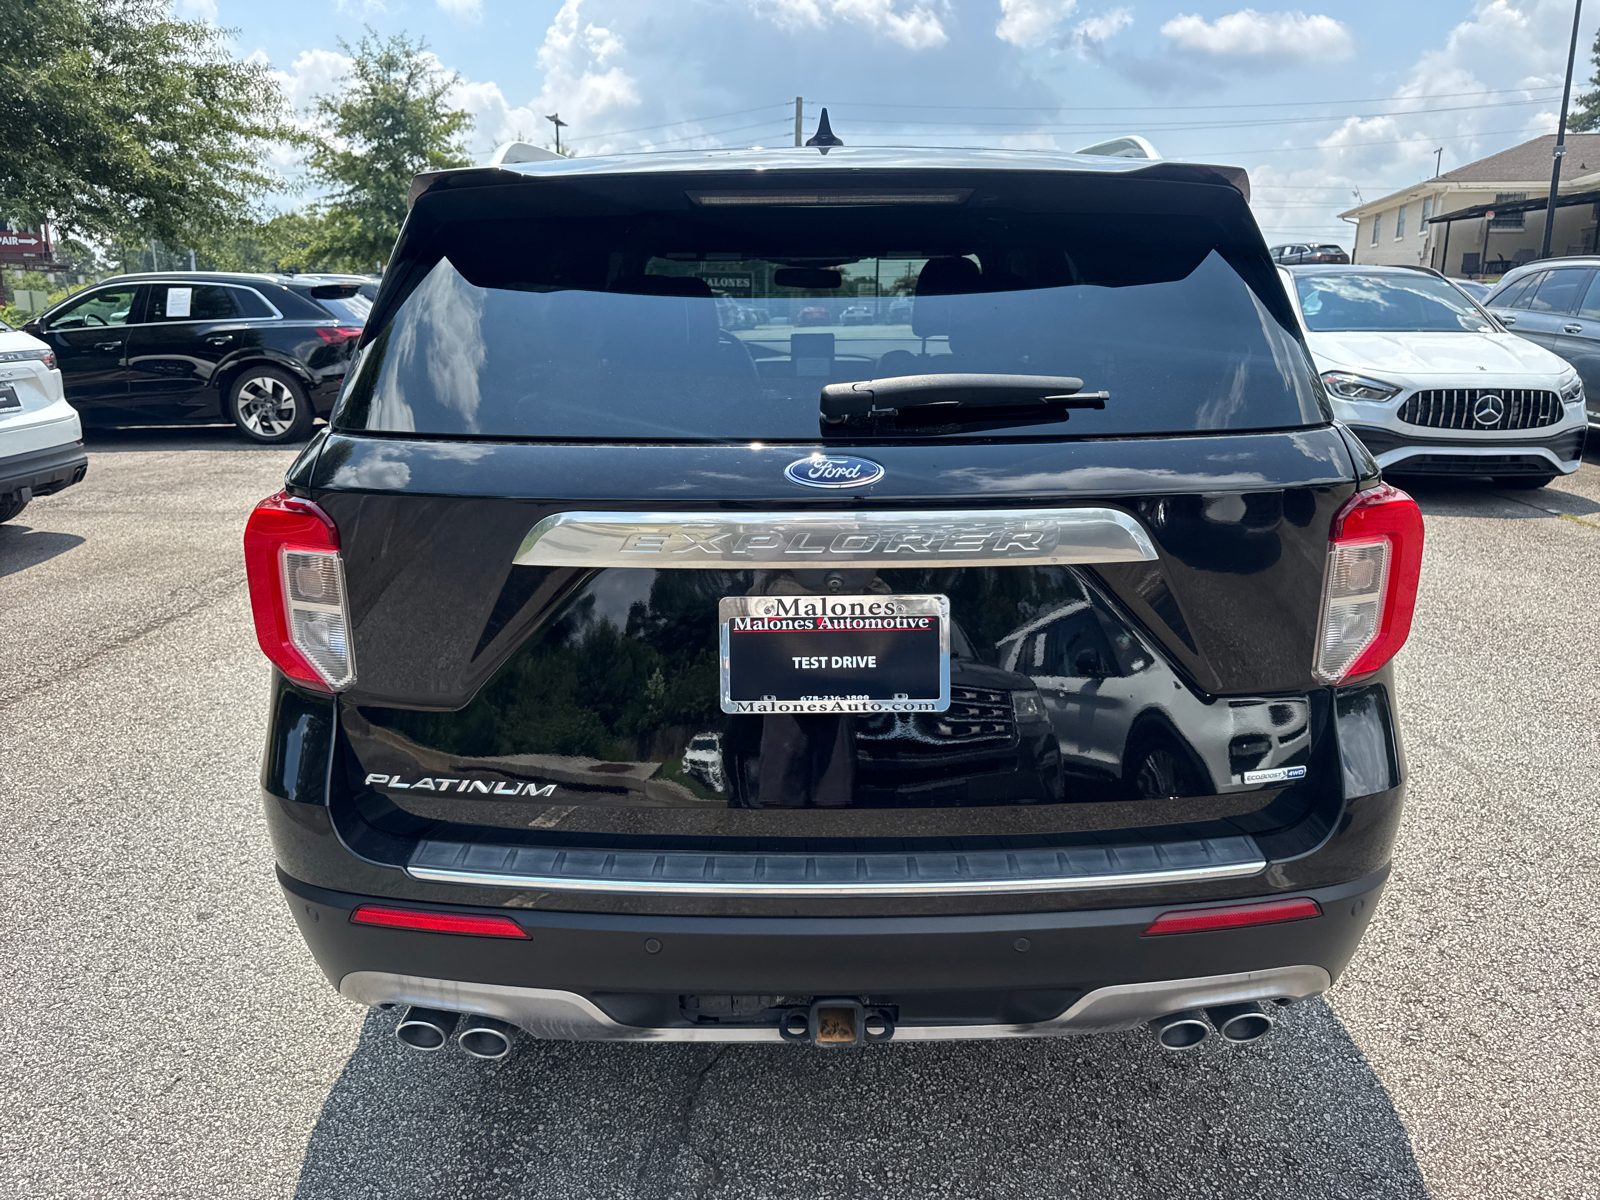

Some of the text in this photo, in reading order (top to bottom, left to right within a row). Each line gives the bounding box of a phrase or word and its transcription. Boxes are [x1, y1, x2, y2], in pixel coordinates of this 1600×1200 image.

[0, 236, 19, 246] AIR
[703, 278, 751, 287] ALONES
[808, 459, 862, 478] Ford
[619, 529, 1044, 554] EXPLORER
[775, 598, 895, 617] Malones
[733, 616, 930, 631] Malones Automotive
[792, 656, 877, 669] TEST DRIVE
[735, 701, 937, 713] MalonesAuto.com
[1288, 769, 1304, 778] 4WD
[364, 773, 558, 797] PLATINUM
